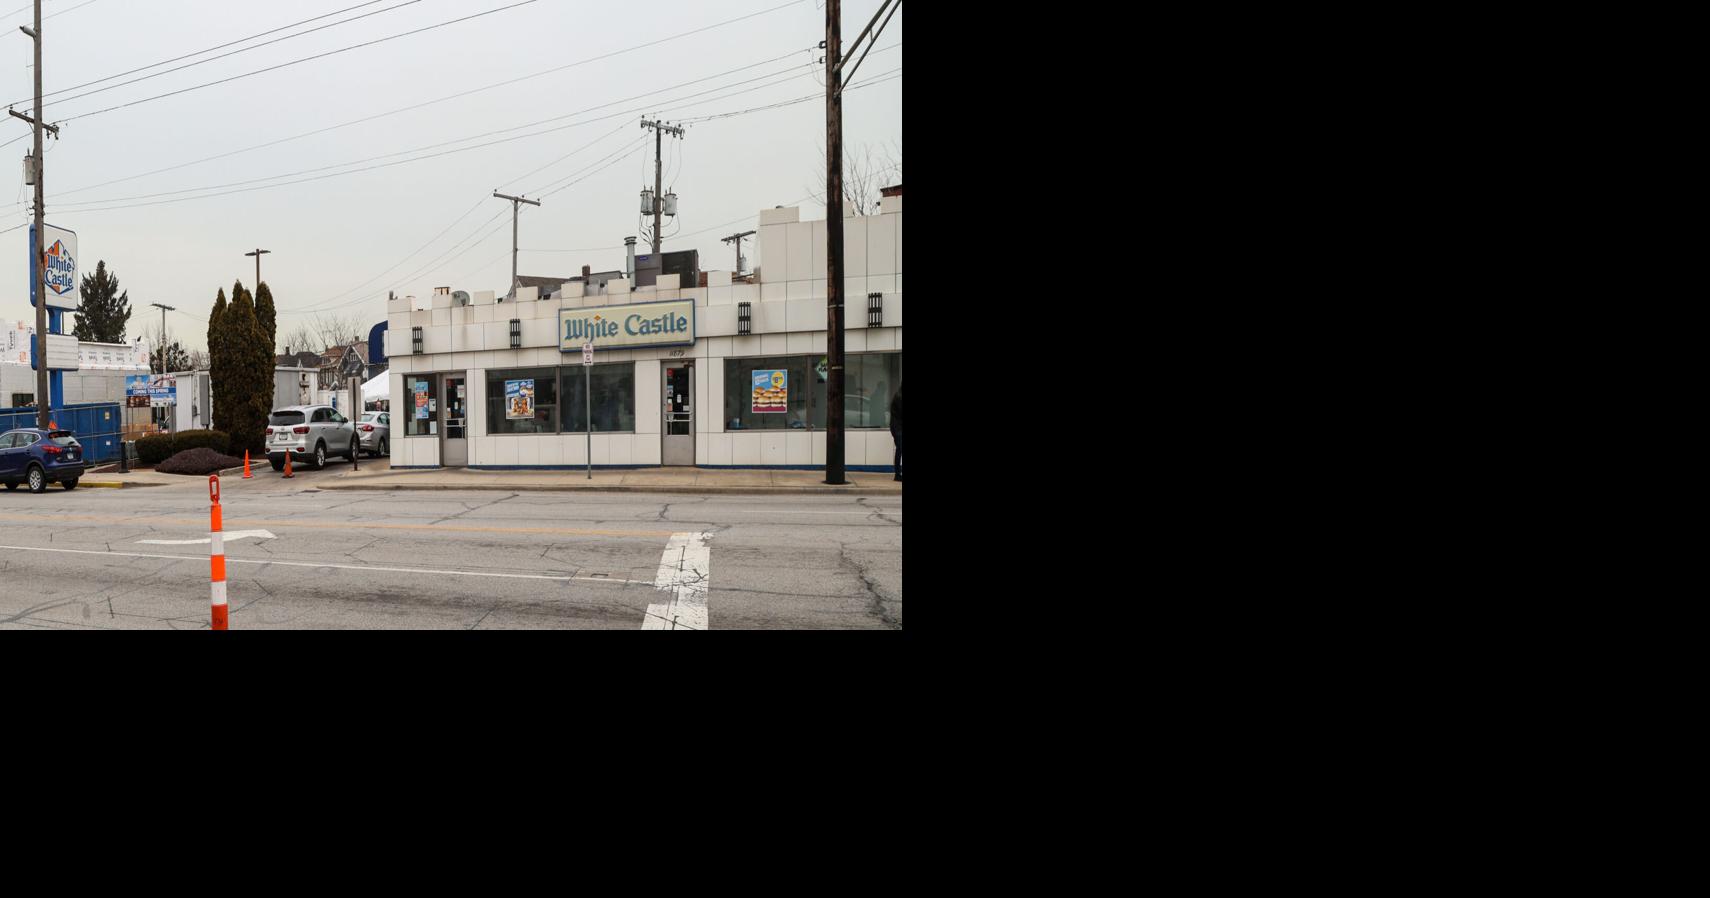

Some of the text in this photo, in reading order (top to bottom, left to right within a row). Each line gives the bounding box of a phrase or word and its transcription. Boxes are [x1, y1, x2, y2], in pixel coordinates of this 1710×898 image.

[48, 254, 71, 273] White
[45, 270, 73, 287] Castle
[564, 312, 687, 343] White Castle
